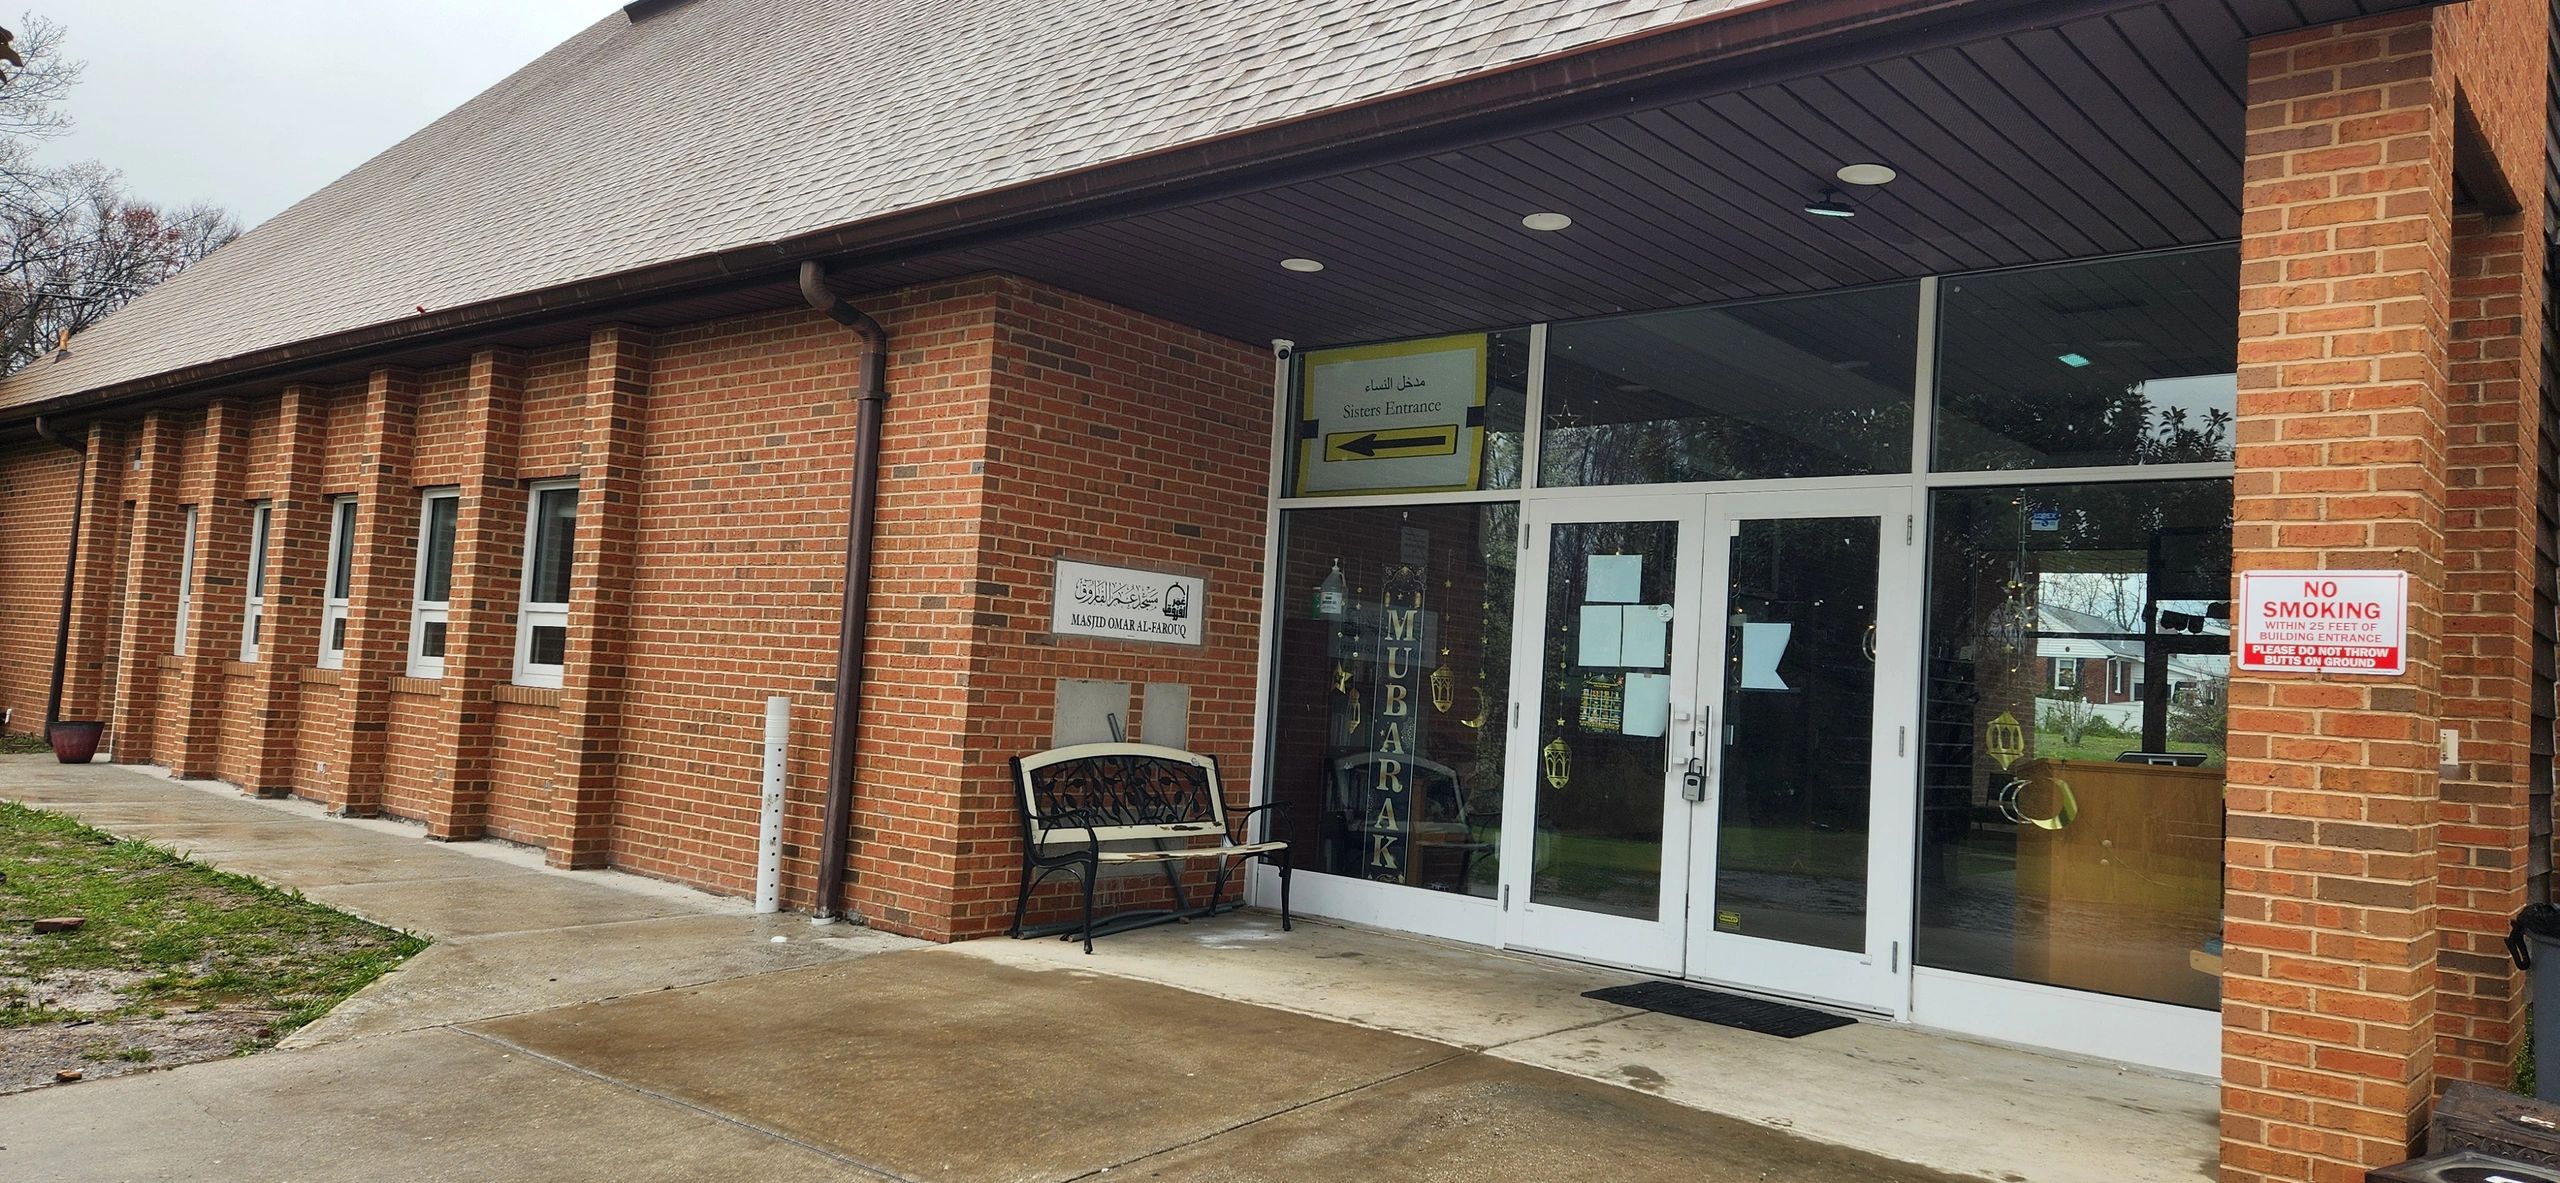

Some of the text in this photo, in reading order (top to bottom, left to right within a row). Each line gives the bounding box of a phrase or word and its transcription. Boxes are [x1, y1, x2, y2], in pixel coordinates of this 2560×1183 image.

[1365, 375, 1426, 393] مدخل النساء
[1343, 400, 1442, 419] Sisters Entrance
[2304, 581, 2337, 598] NO
[2263, 601, 2381, 619] SMOKING
[1071, 613, 1187, 639] MASJID OMAR AL-FAROUQ
[2265, 621, 2377, 632] WITHIN 25 FEET OF
[2259, 632, 2382, 643] BUILDING ENTRANCE
[2252, 645, 2390, 658] PLEASE DO NOT THROW
[2264, 655, 2376, 668] BUTTS ON GROUND
[1370, 609, 1418, 870] MUBARAK
